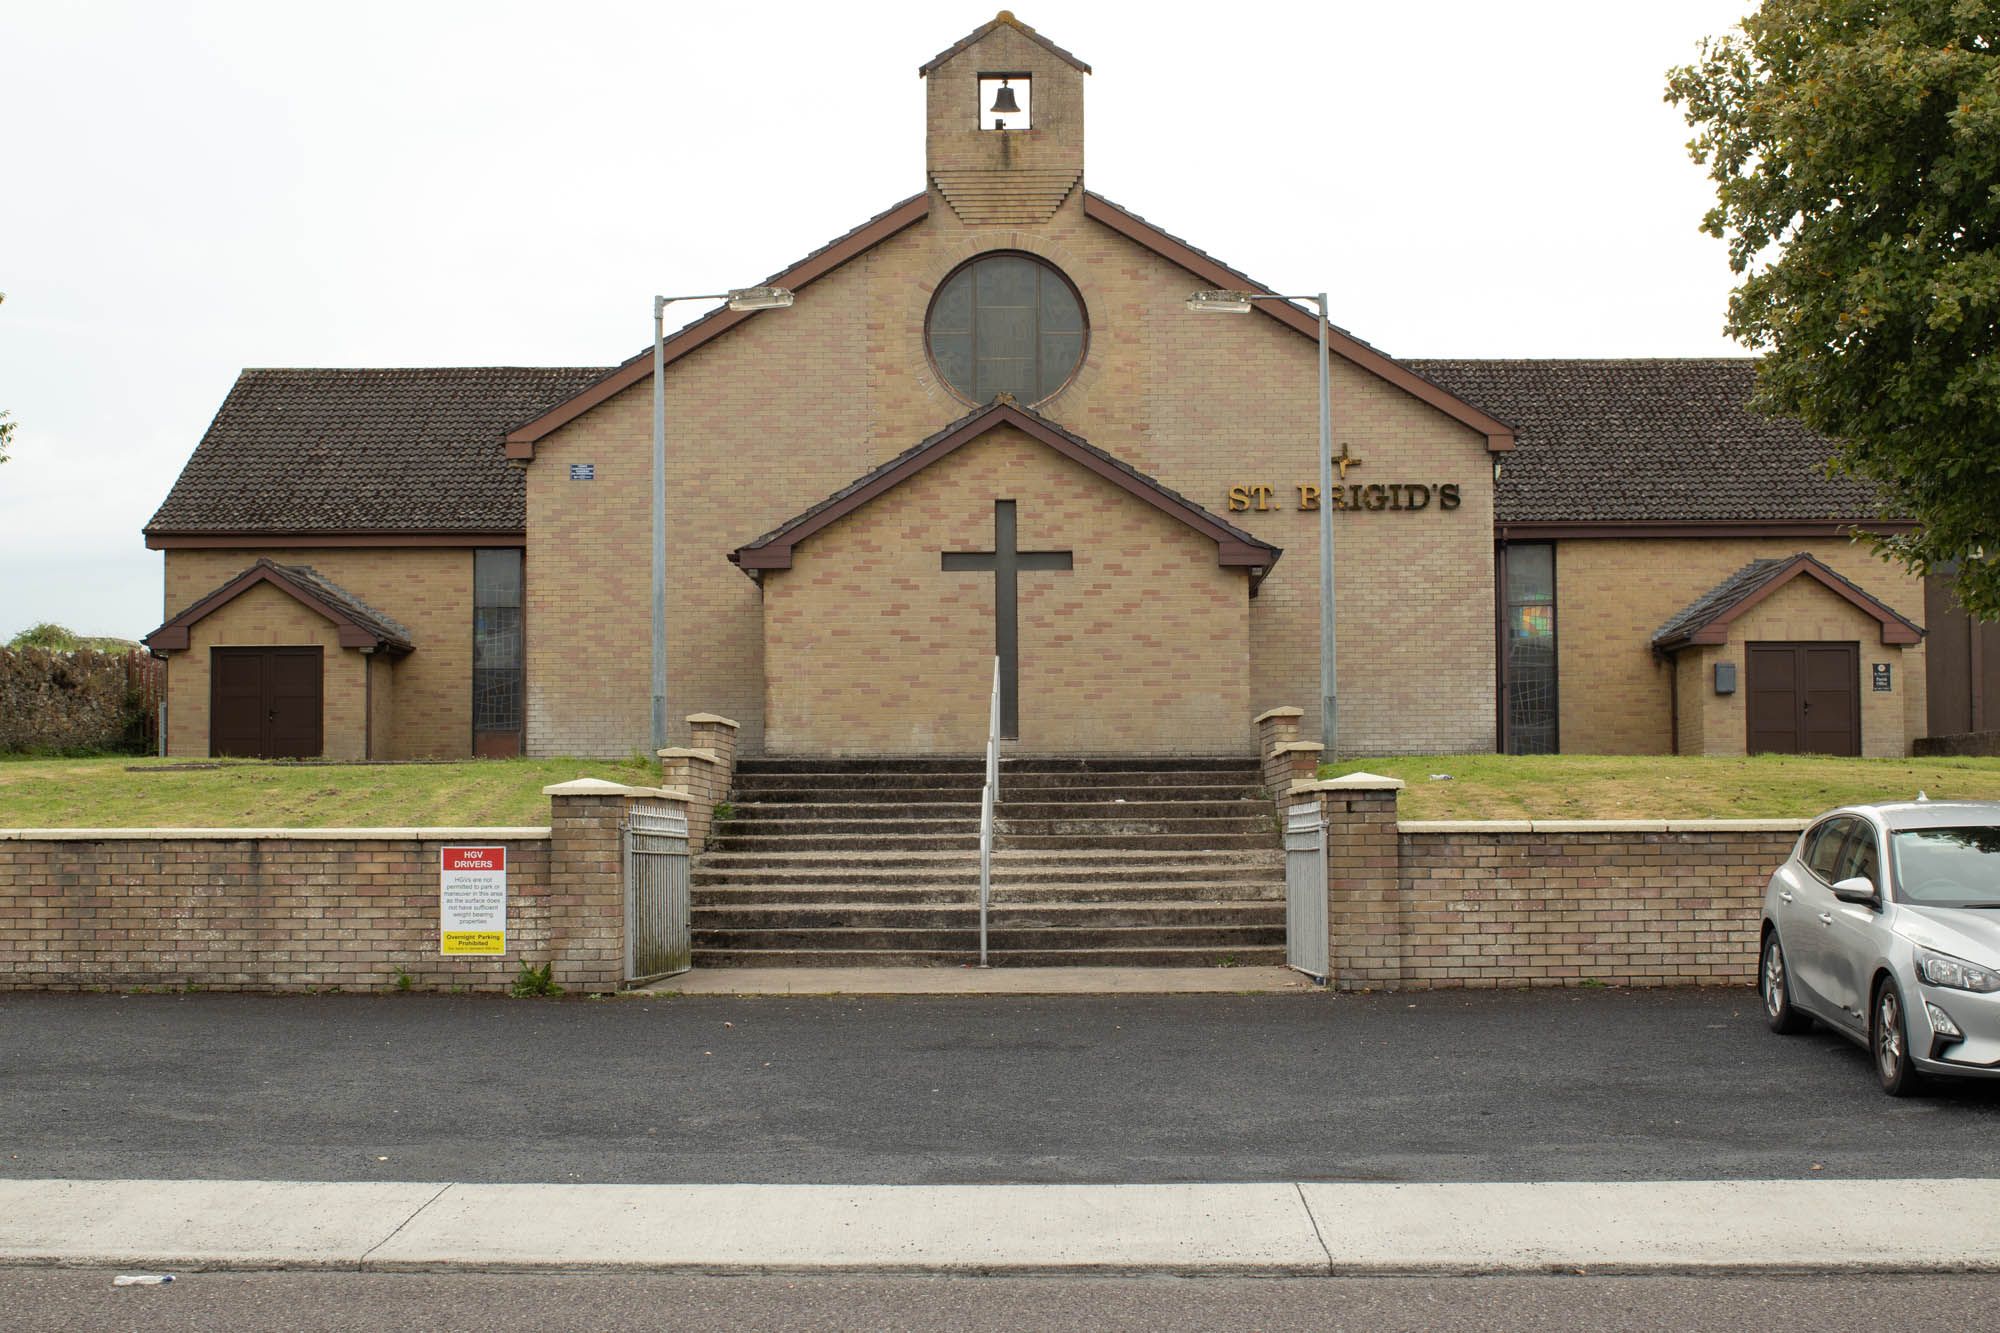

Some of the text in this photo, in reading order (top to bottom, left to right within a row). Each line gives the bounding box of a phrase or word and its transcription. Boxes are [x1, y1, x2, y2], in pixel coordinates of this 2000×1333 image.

[1228, 483, 1462, 512] ST. BRIGID'S
[454, 860, 493, 868] DRIVERS
